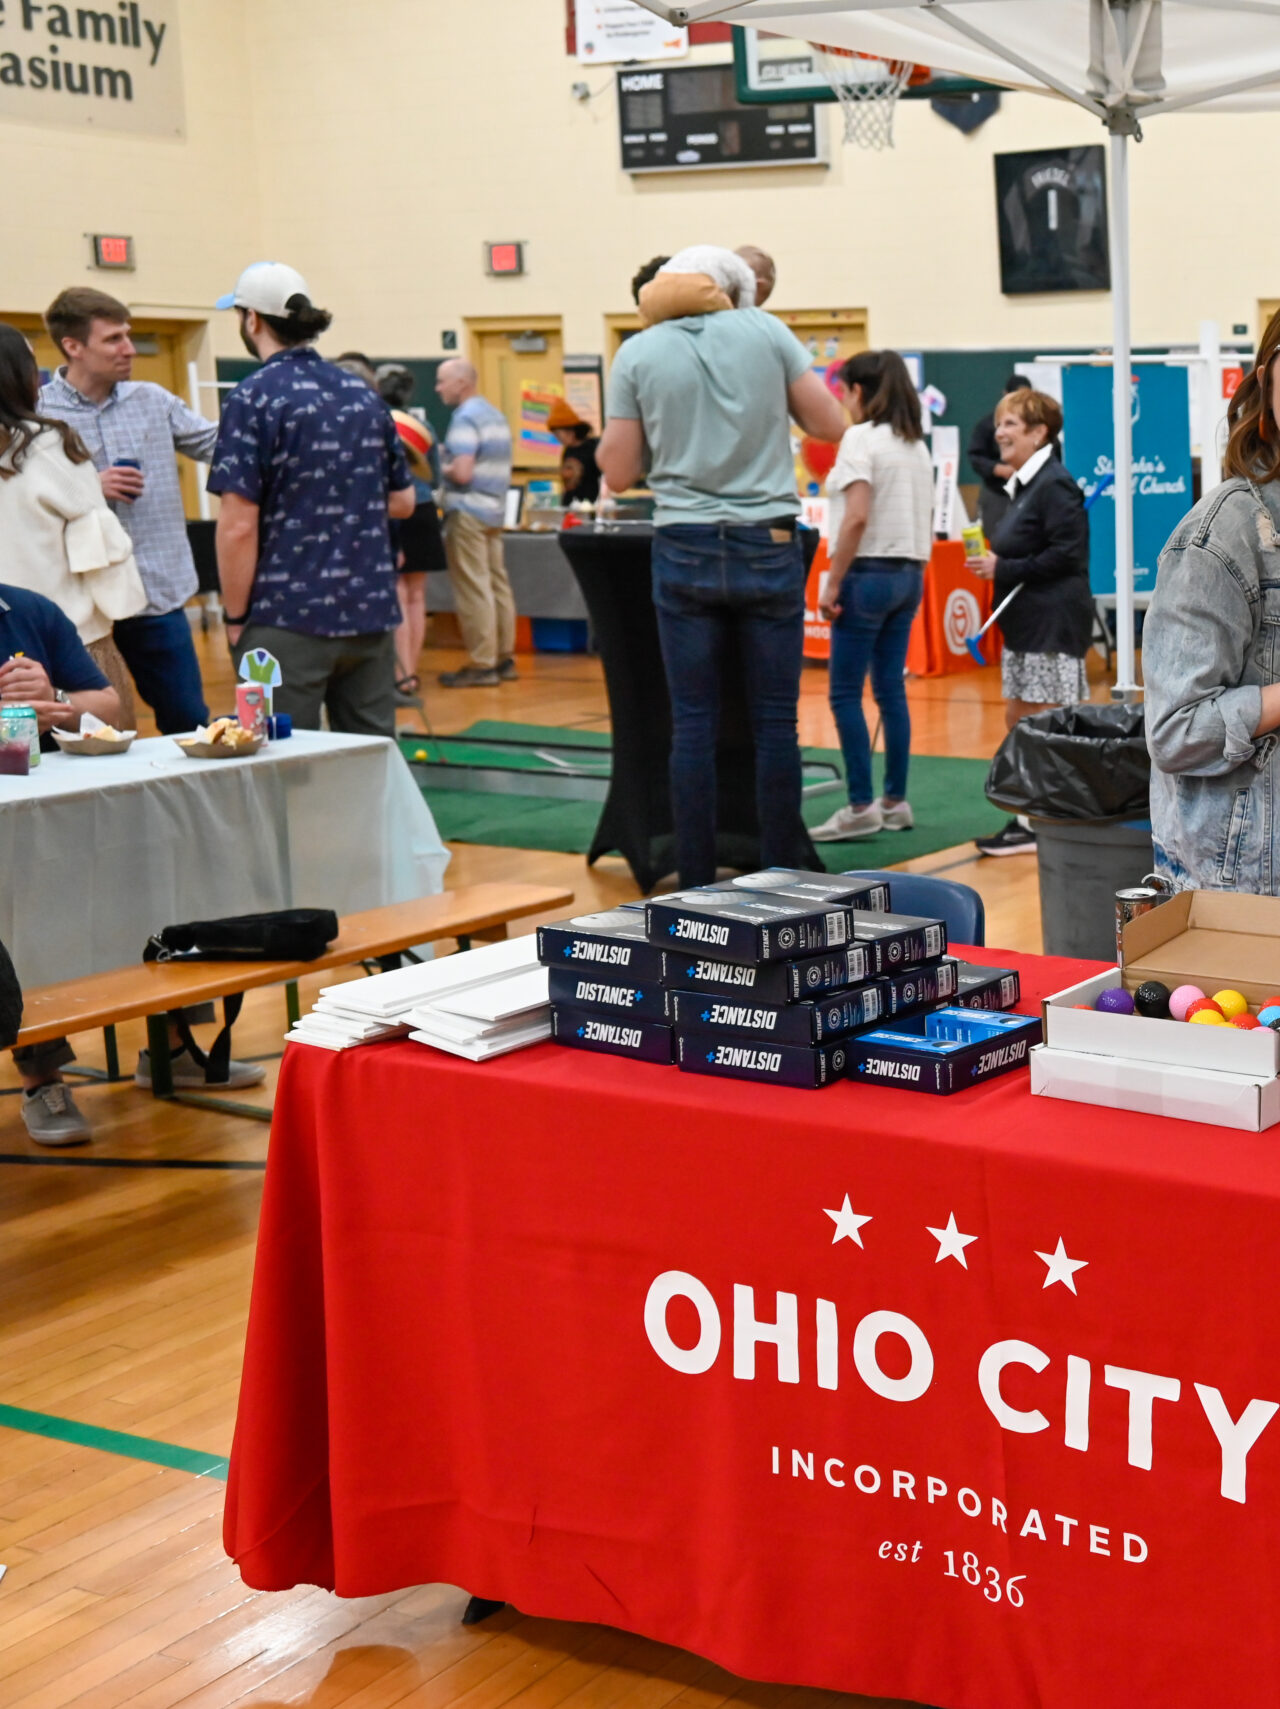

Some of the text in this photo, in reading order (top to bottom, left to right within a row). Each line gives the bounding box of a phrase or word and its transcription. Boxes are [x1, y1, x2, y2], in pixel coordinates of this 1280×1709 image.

[21, 0, 166, 66] Family
[621, 74, 664, 91] HOME
[1139, 476, 1187, 495] Church
[644, 1270, 1280, 1504] OHIO CITY
[771, 1446, 1149, 1563] INCORPORATED
[878, 1540, 1027, 1608] est 1836
